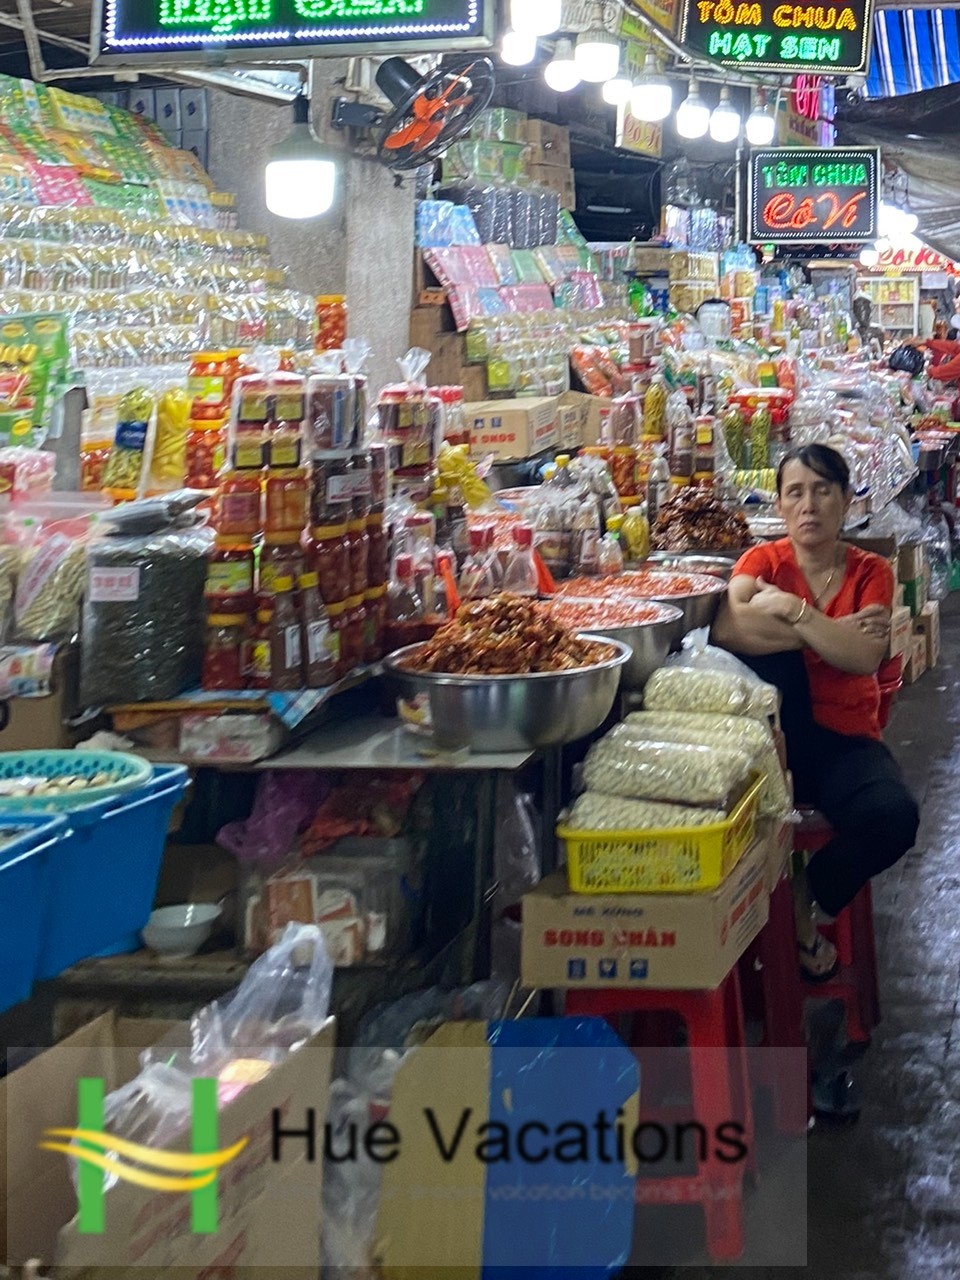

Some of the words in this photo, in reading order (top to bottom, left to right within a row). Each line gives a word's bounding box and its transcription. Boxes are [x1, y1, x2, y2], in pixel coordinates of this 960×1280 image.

[772, 4, 857, 31] CHUA
[708, 30, 772, 61] HẠT
[779, 35, 841, 61] SEN
[762, 160, 809, 189] TÔM
[812, 163, 868, 187] CHUA
